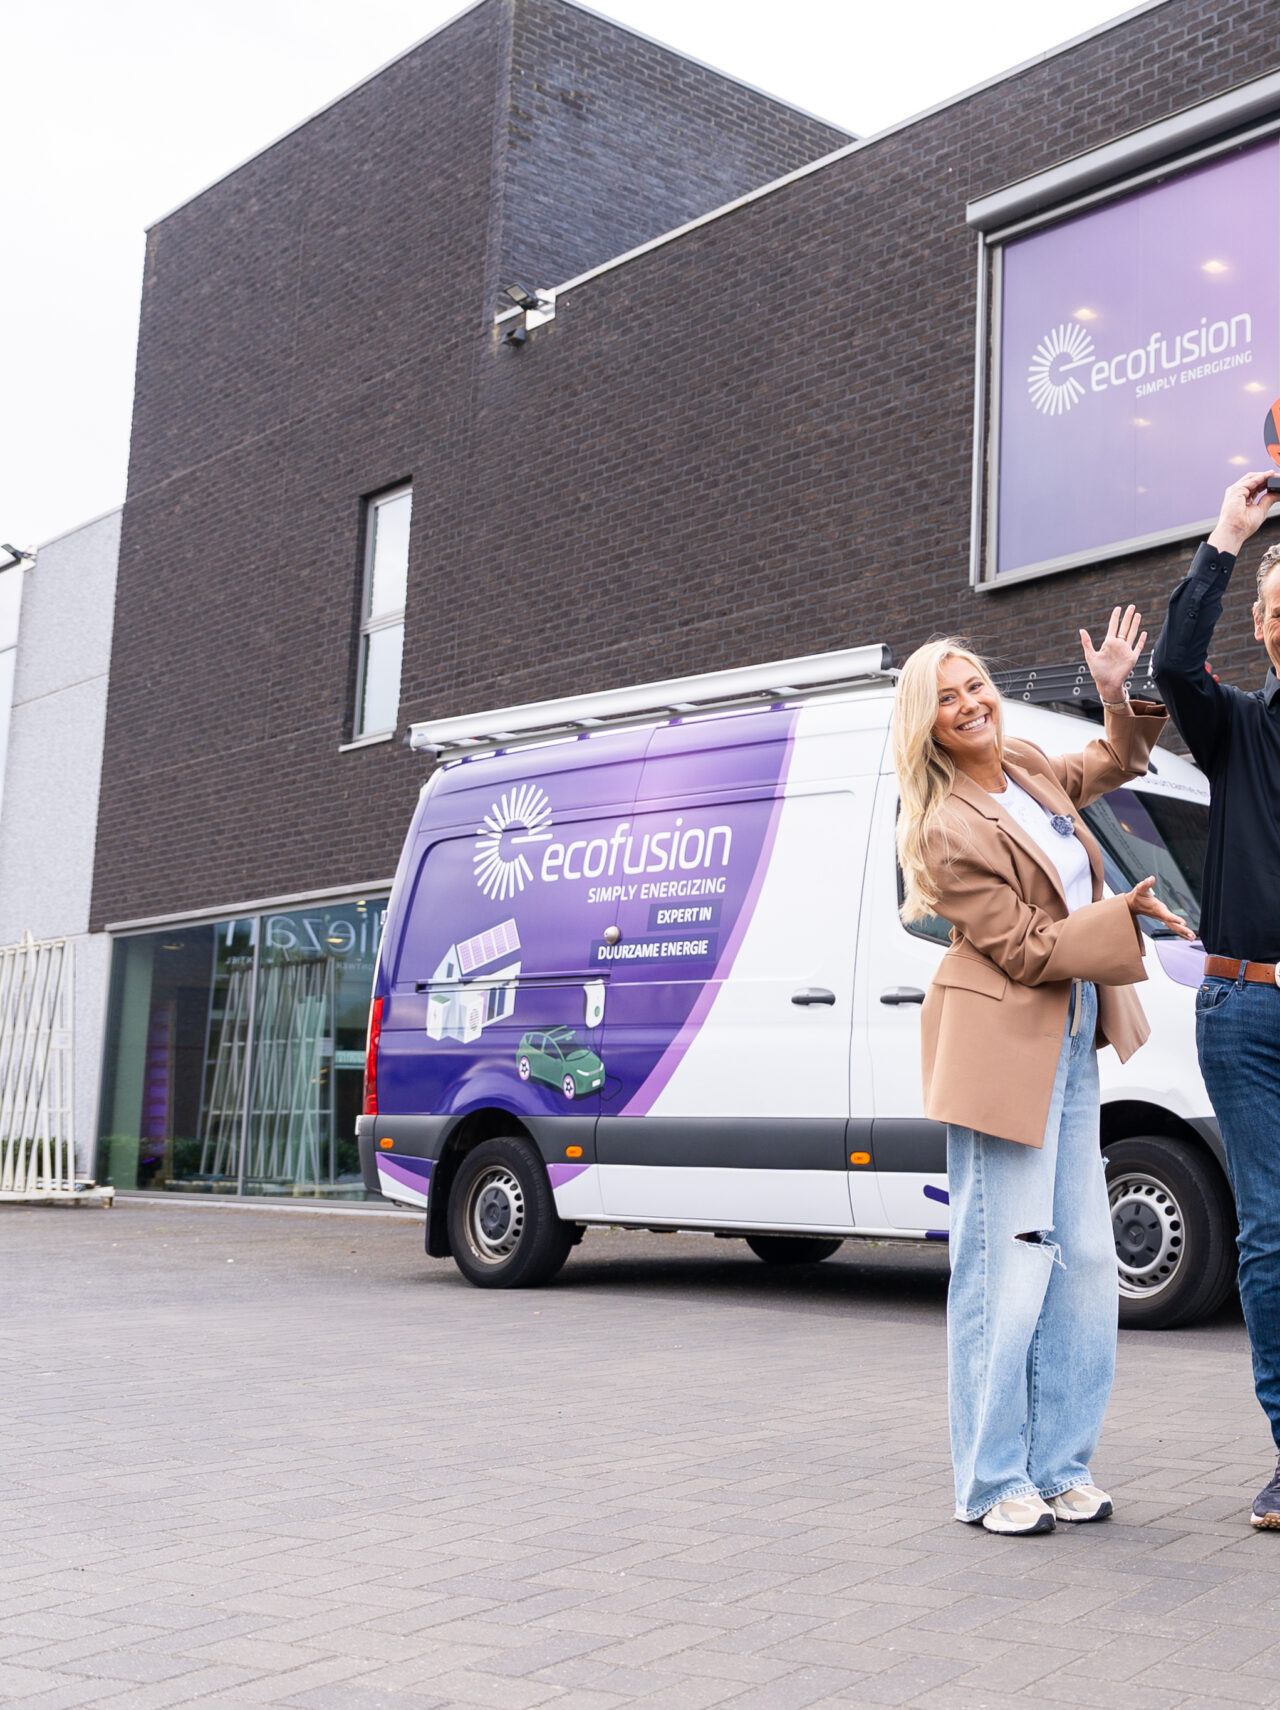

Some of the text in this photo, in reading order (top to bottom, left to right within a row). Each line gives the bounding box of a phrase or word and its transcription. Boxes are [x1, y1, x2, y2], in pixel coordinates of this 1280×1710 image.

[1090, 312, 1252, 391] ecofusion
[1135, 350, 1253, 398] SIMPLY ENERGIZING
[540, 817, 733, 882] ecofusion
[587, 877, 727, 904] SIMPLY ENERGIZING
[656, 906, 713, 925] EXPERT IN
[597, 939, 709, 960] DUURZAME ENERGIE
